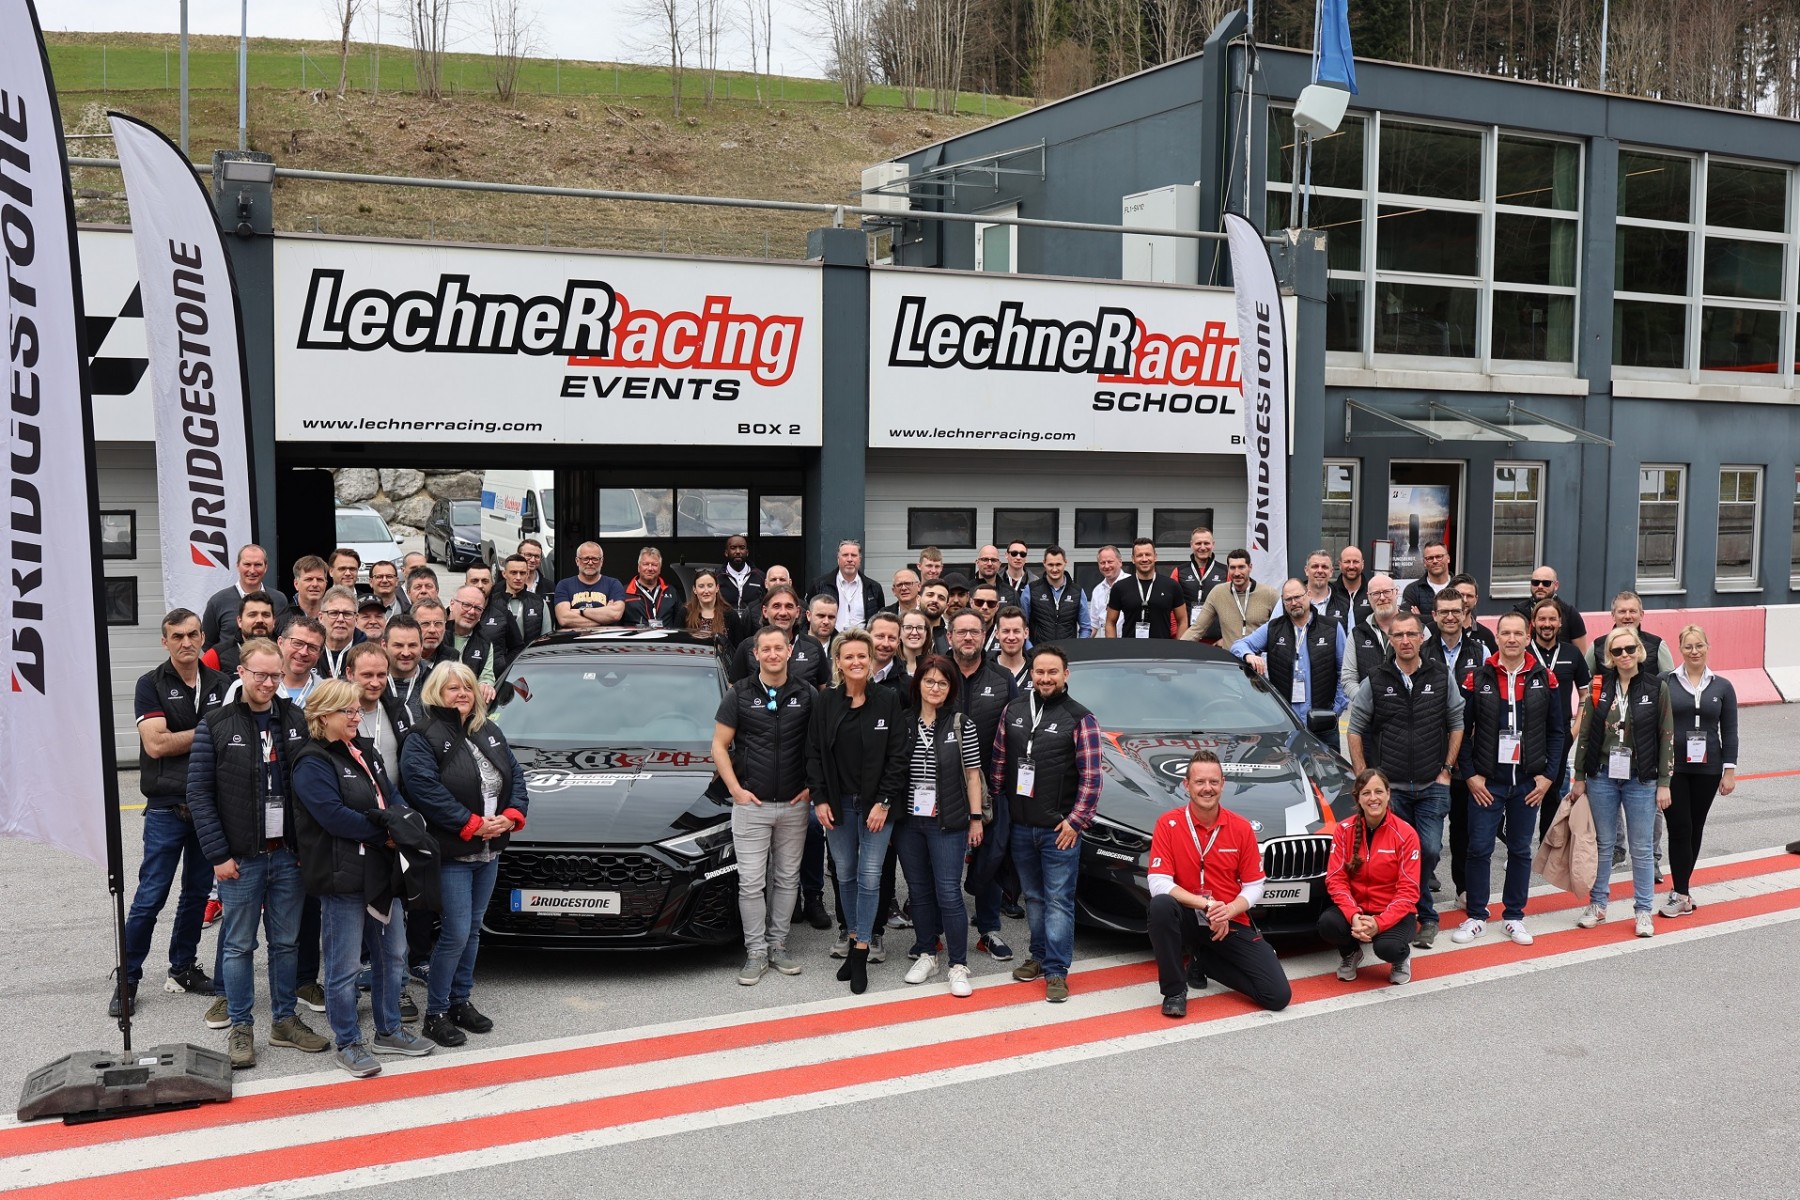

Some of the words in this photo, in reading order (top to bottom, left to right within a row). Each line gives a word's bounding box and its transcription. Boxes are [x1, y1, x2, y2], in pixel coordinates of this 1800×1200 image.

[560, 375, 741, 401] EVENTS
[169, 238, 230, 571] BRIDGESTONE
[1093, 391, 1236, 415] SCHOOL
[302, 417, 543, 433] www.lechnerracing.com
[737, 423, 777, 435] BOX
[788, 424, 801, 435] 2
[1252, 300, 1271, 554] BRIDGESTONE
[889, 427, 1076, 442] www.lechnerracing.com
[1096, 848, 1135, 863] BRIDGESTONE
[1262, 888, 1302, 899] ESTONE
[530, 896, 610, 909] BRIDGESTONE
